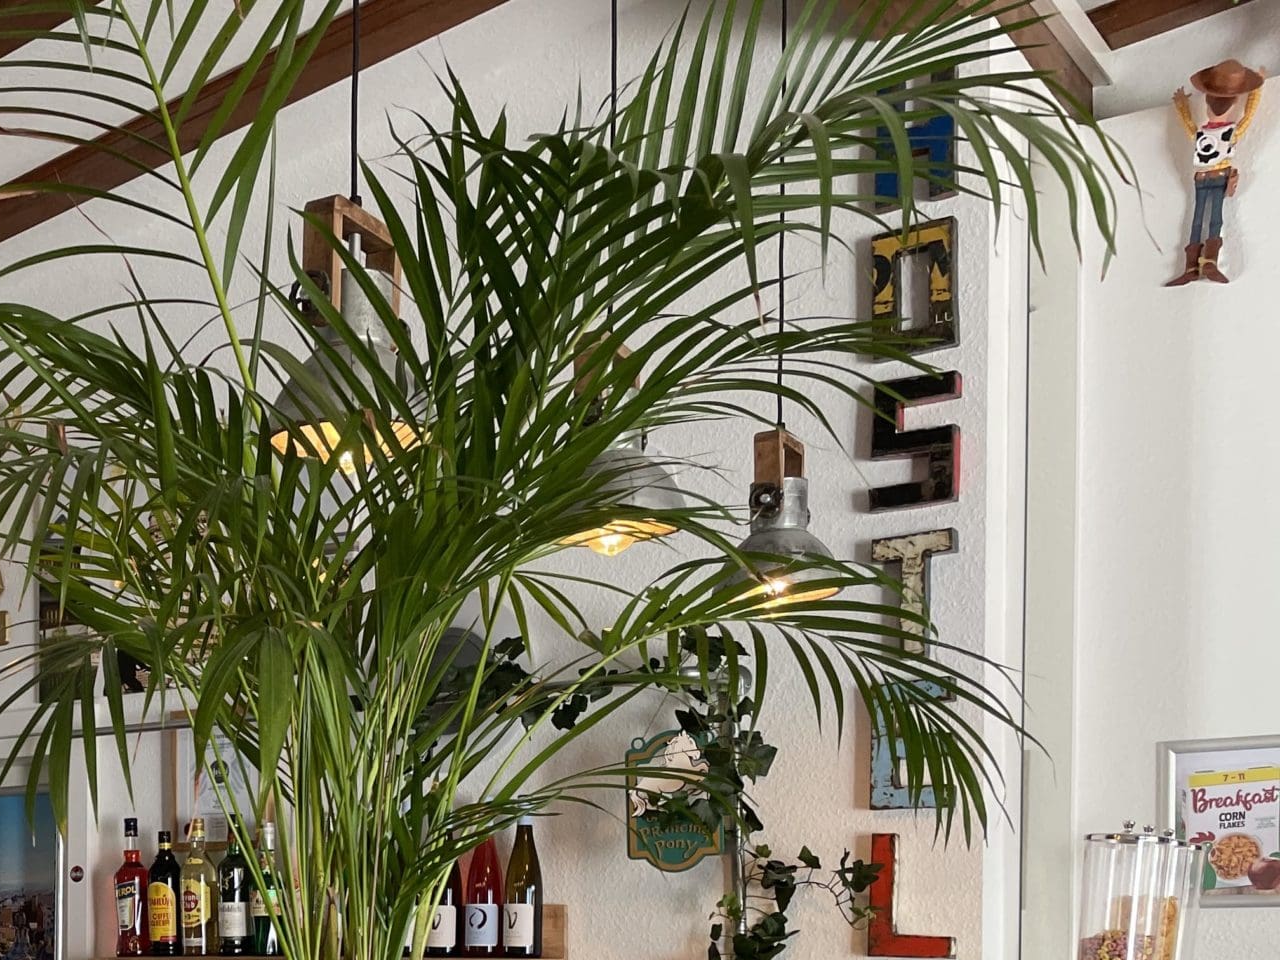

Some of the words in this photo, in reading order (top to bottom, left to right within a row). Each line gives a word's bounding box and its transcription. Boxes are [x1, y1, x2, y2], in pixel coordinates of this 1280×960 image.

[1222, 774, 1229, 782] 7
[1190, 785, 1280, 813] Breakfast
[1218, 811, 1246, 822] CORN
[1219, 821, 1246, 829] FLAKES
